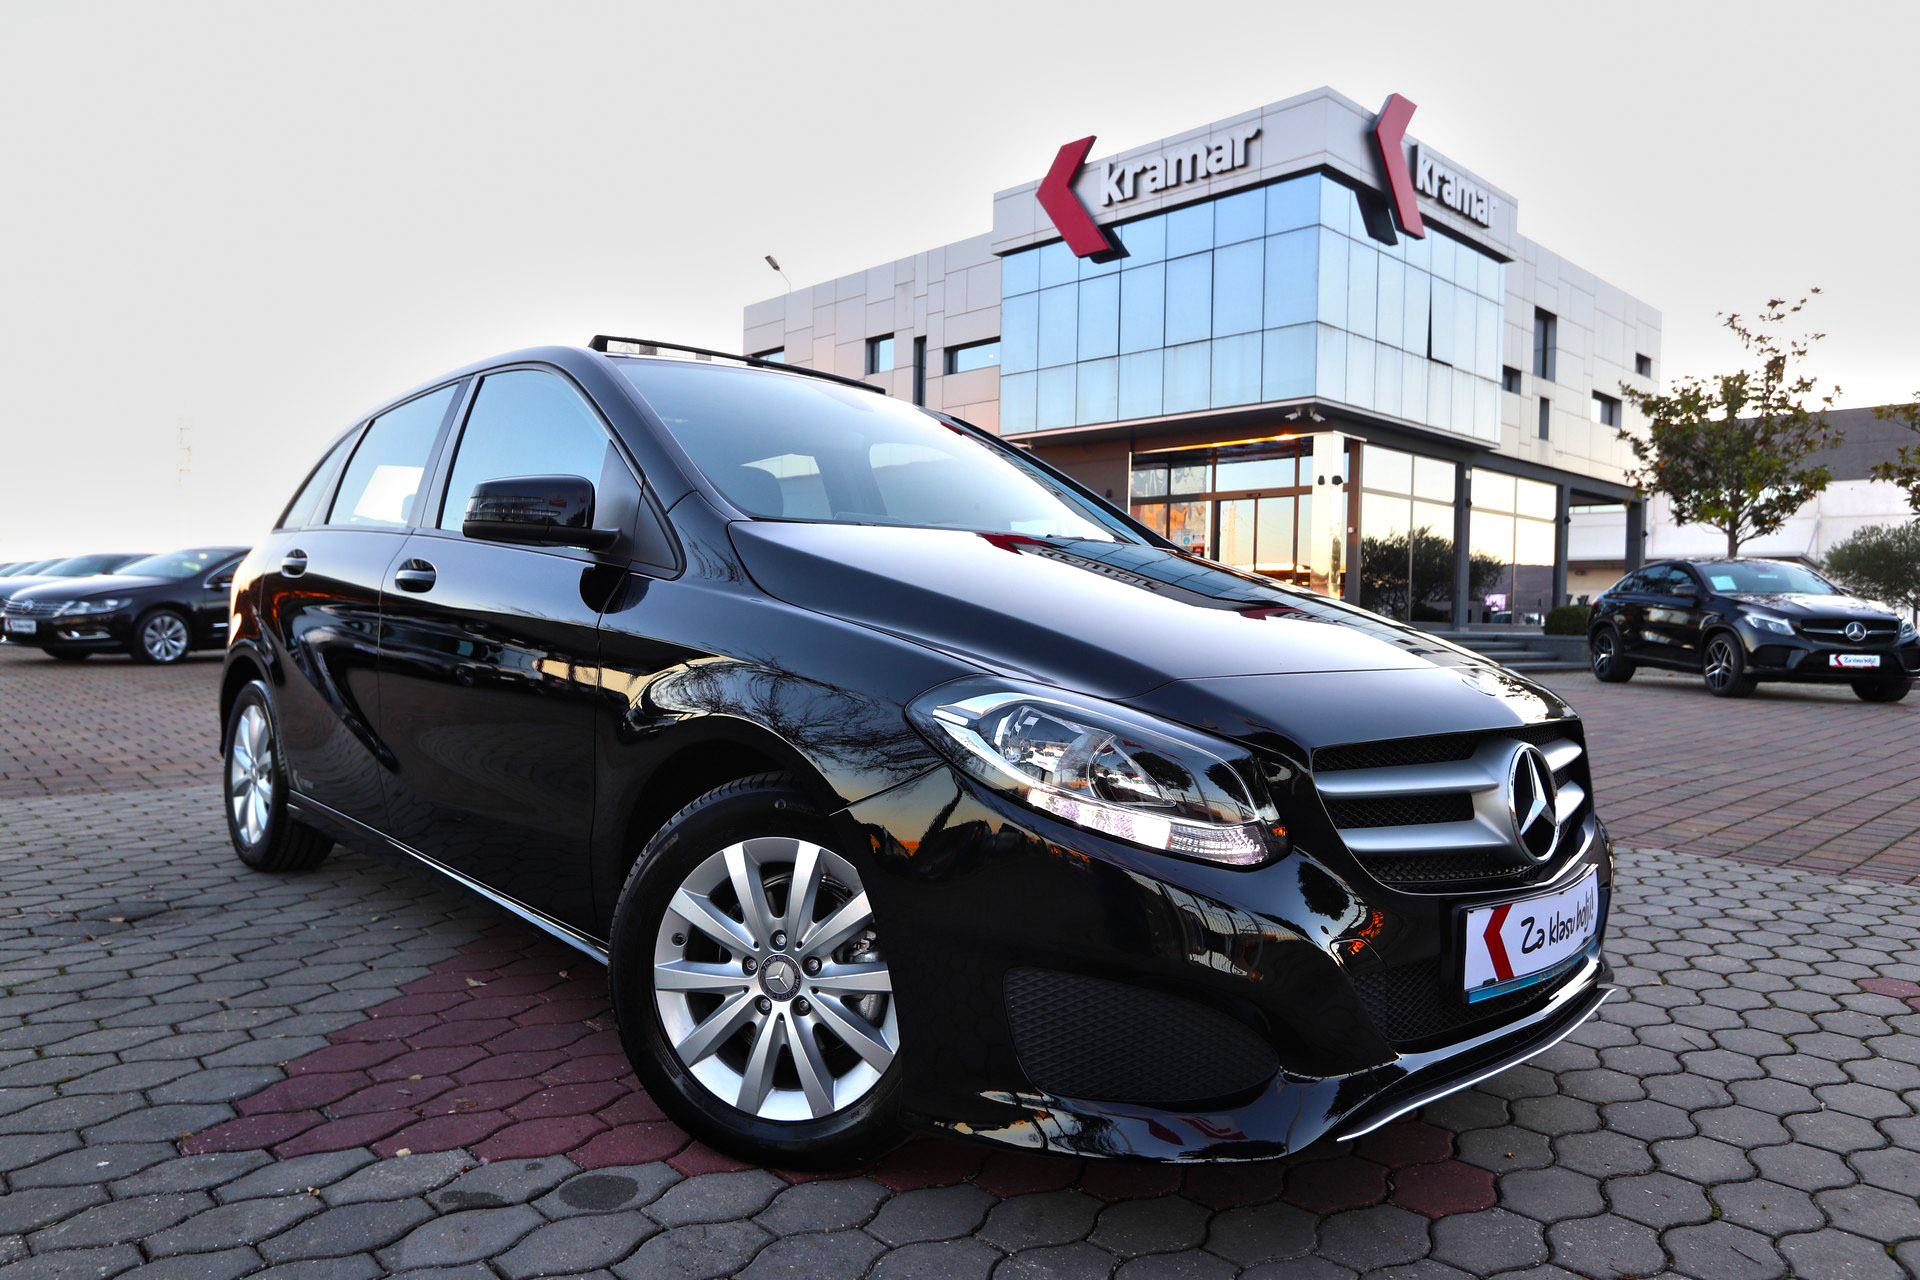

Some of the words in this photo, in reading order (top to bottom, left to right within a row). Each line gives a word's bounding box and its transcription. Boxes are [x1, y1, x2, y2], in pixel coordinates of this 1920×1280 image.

[1100, 127, 1262, 206] kramar
[1520, 916, 1545, 954] Za
[1549, 910, 1576, 946] klasu
